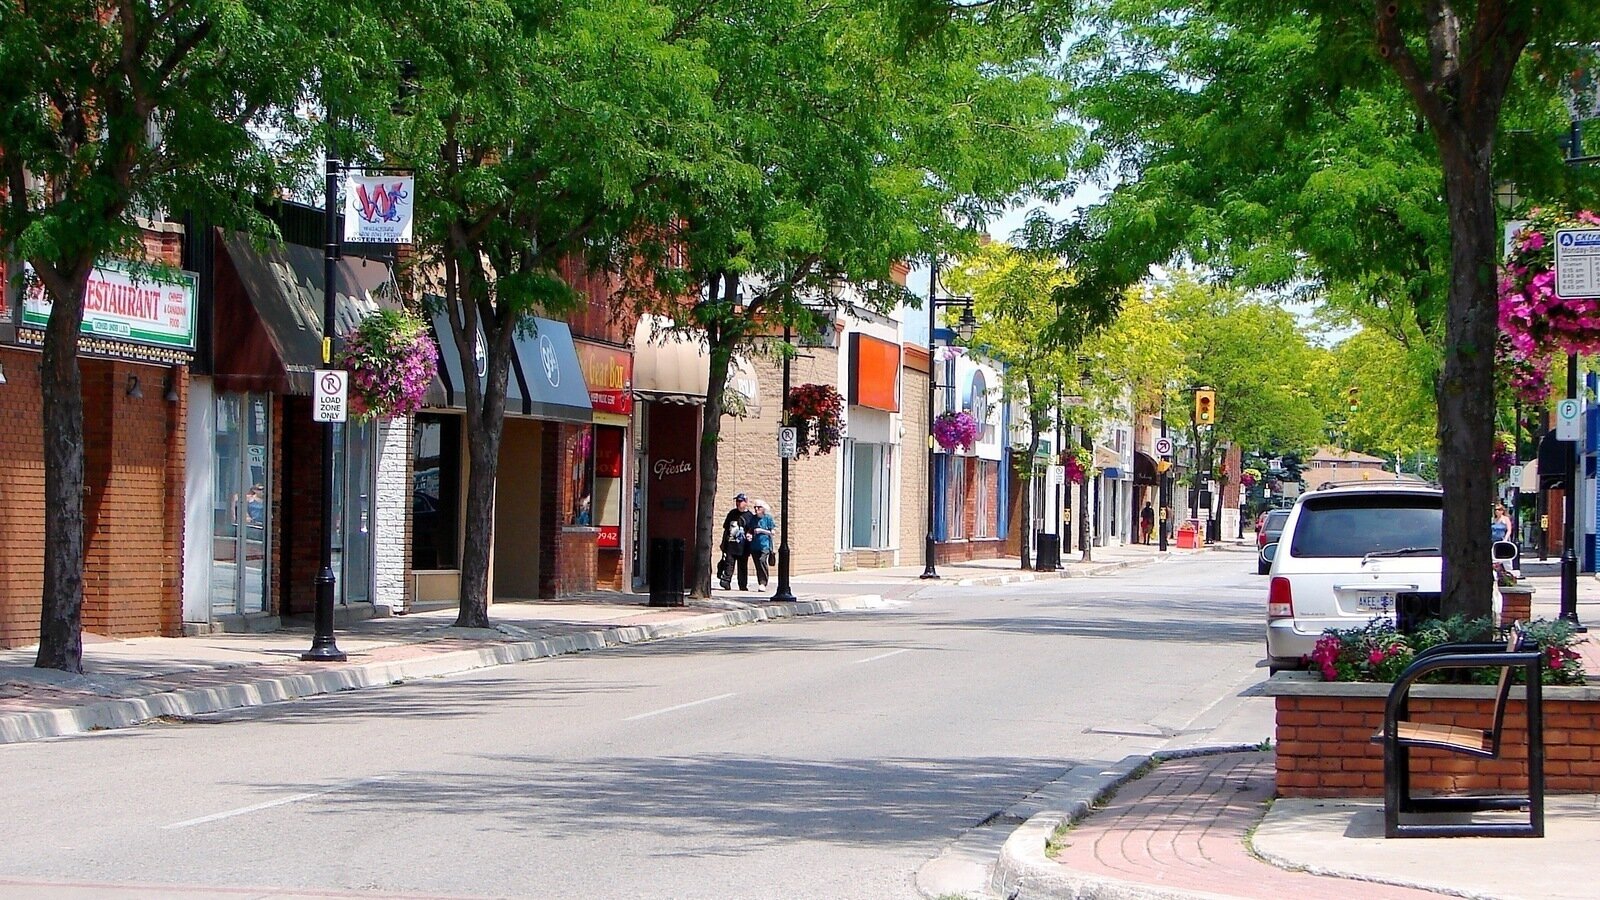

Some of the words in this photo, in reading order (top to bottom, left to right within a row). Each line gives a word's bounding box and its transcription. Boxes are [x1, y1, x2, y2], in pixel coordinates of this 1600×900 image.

[1562, 235, 1571, 244] A
[84, 280, 161, 321] ESTAURANT
[590, 352, 608, 387] Gear
[609, 355, 623, 389] Box
[653, 459, 692, 480] Fiesta
